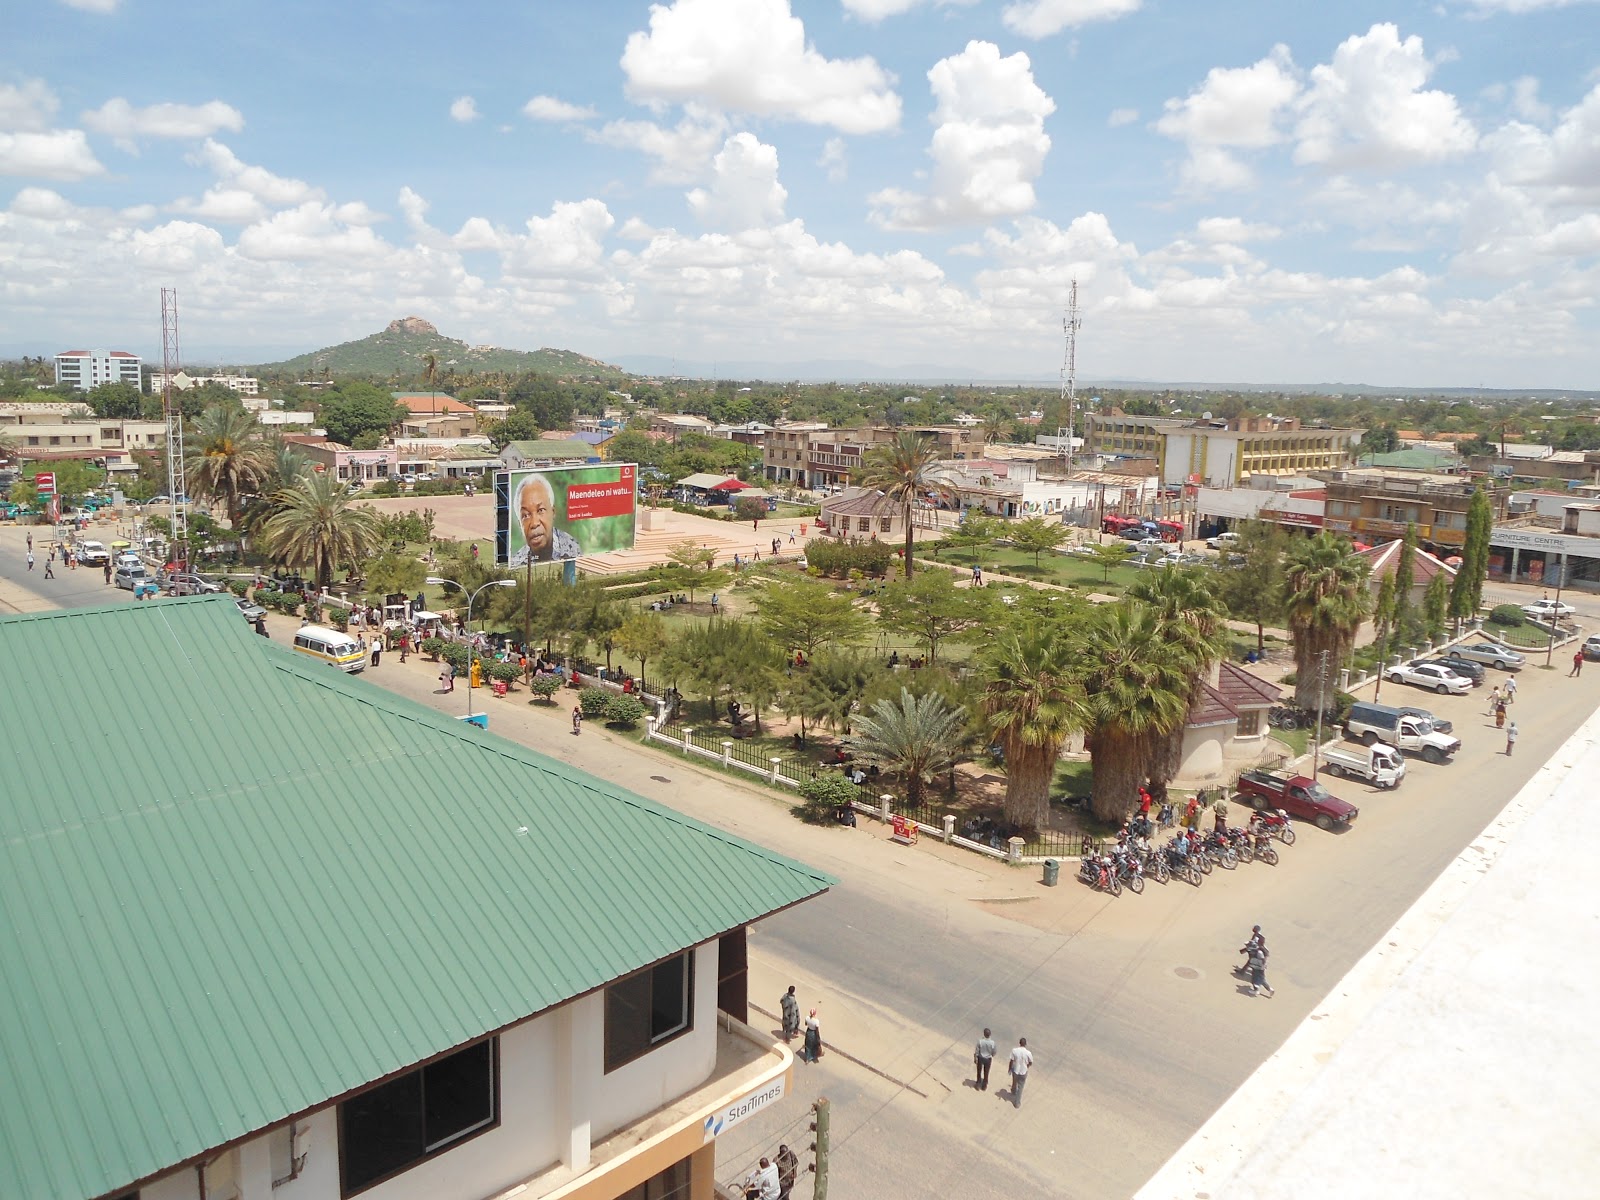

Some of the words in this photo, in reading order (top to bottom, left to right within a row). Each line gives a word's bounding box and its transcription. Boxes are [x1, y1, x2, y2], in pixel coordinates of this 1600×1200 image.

[569, 489, 605, 500] Maendeleo
[605, 488, 612, 497] ni
[1491, 532, 1531, 542] FURNITURE
[1534, 537, 1566, 546] CENTRE
[728, 1085, 781, 1122] StarTimes
